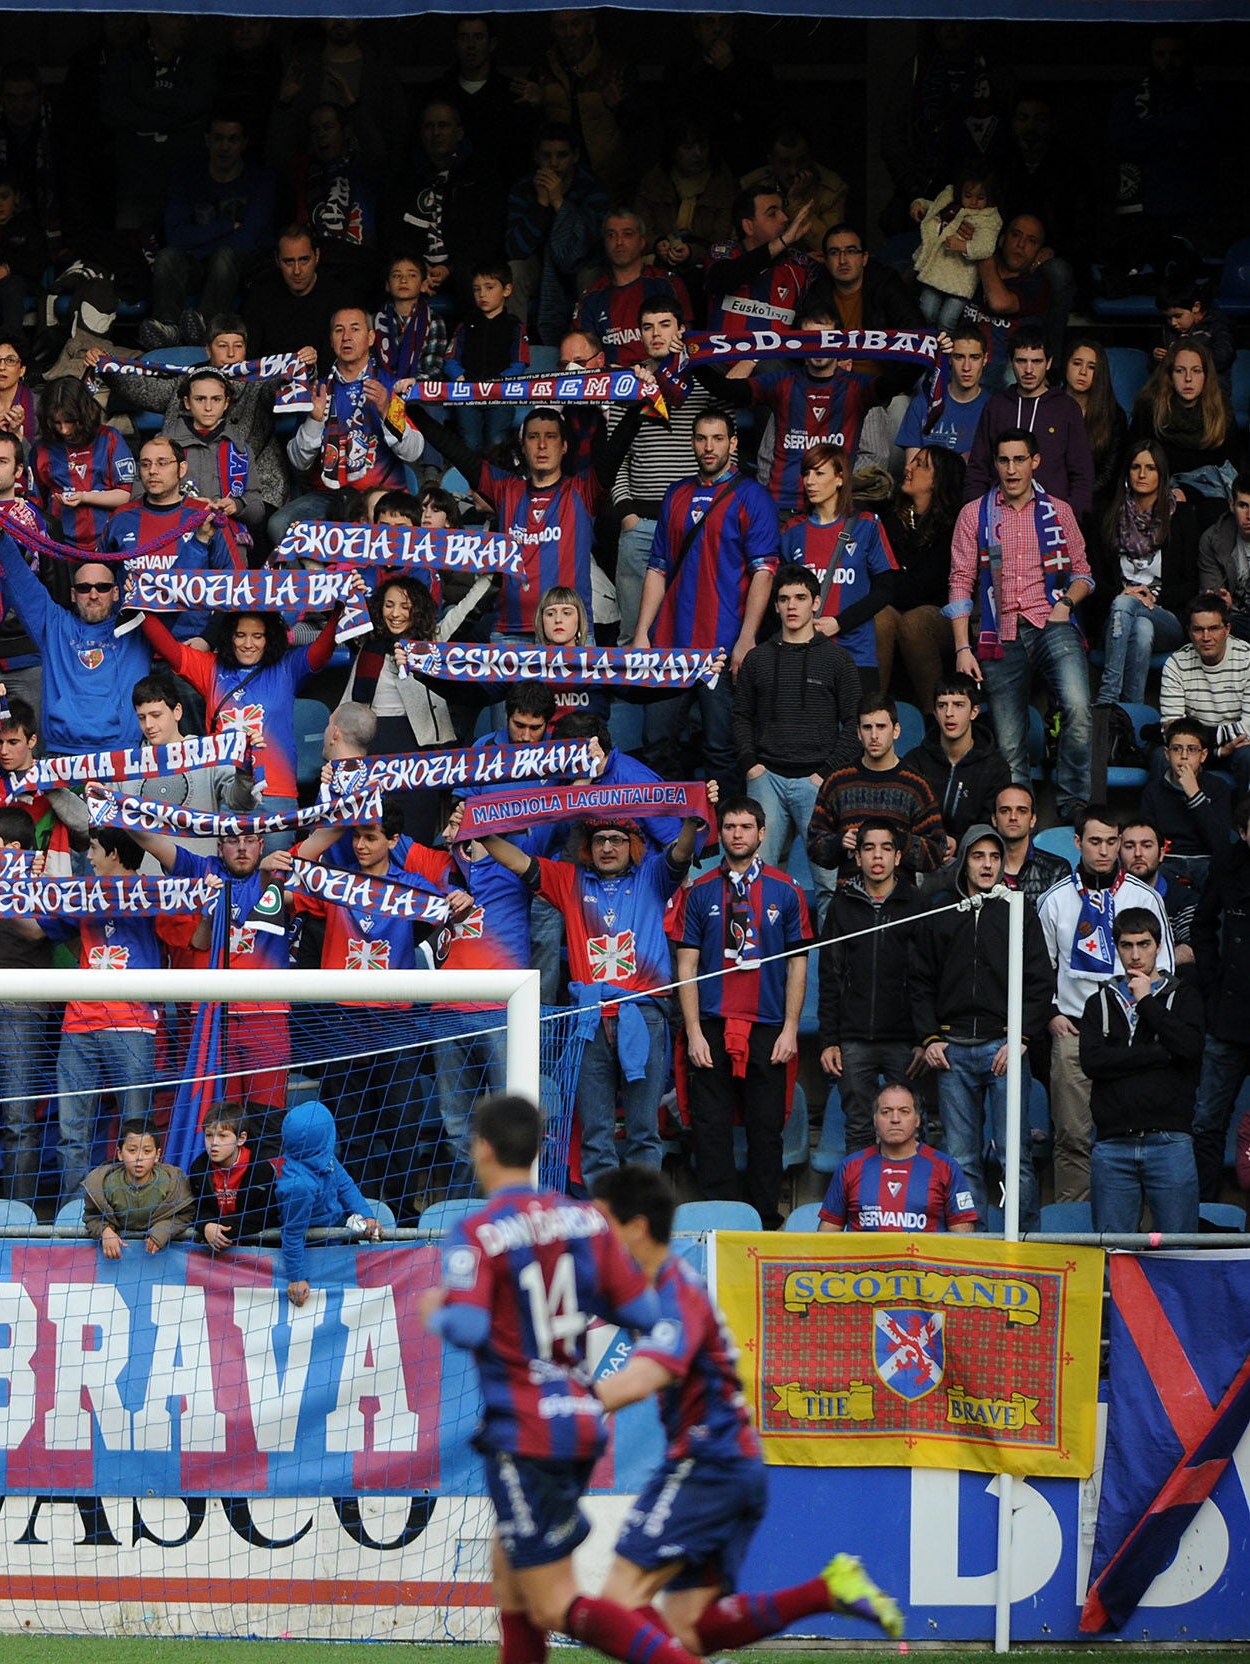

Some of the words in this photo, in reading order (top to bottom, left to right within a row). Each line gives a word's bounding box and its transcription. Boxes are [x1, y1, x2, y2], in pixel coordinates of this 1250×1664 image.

[602, 328, 642, 345] SERVAN
[710, 331, 802, 353] S.D.
[820, 329, 938, 359] EIBAR
[401, 530, 436, 562] LA
[123, 555, 178, 571] SERVAN
[139, 572, 253, 607] ESKOZIA
[264, 576, 299, 605] LA
[445, 648, 566, 682] ESKOZIA
[581, 650, 613, 680] LA
[623, 652, 715, 684] BRAVA
[554, 691, 589, 707] ANDO
[124, 745, 158, 774] LA
[165, 730, 248, 772] BRAVA
[368, 755, 468, 793] ESKOZIA
[475, 750, 505, 781] LA
[511, 742, 590, 778] BRAVA
[121, 797, 241, 837] ESKOZIA
[253, 814, 287, 832] LA
[471, 794, 561, 824] MANDIOLA
[567, 786, 688, 808] LAGUNTALDEA
[116, 880, 152, 912] LA
[380, 883, 415, 916] LA
[859, 1211, 927, 1230] SERVANDO
[519, 1252, 588, 1362] 14
[794, 1274, 1029, 1308] SCOTLAND
[803, 1395, 851, 1418] THE
[951, 1399, 1020, 1427] BRAVE
